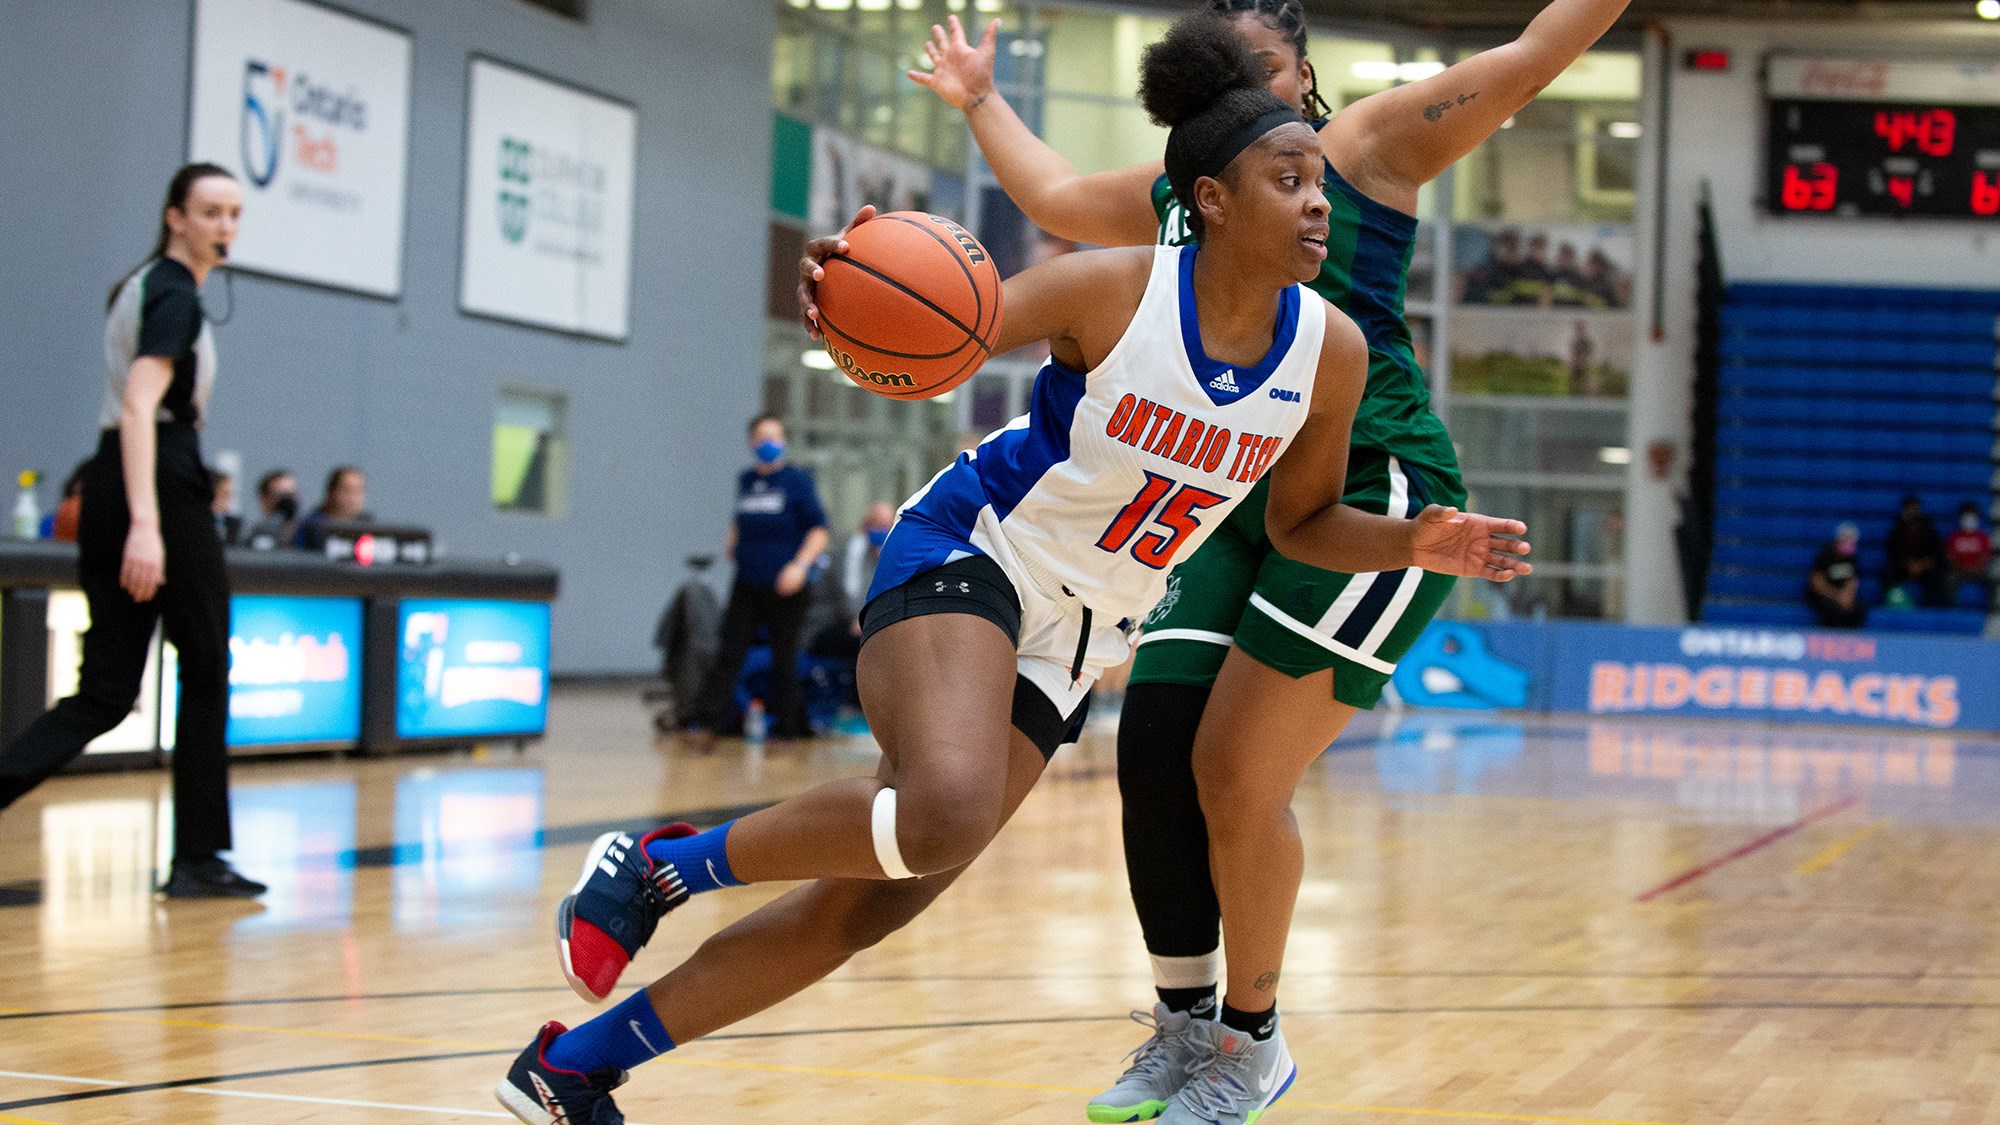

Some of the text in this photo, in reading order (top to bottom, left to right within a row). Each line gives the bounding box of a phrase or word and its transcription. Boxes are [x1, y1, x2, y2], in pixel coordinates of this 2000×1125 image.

[1781, 162, 1839, 210] 63
[1971, 170, 2000, 216] 6
[1209, 381, 1240, 393] adidas
[1106, 393, 1283, 483] ONTARIO TECH
[1094, 469, 1232, 570] 15
[1589, 661, 1960, 727] RIDGEBACKS
